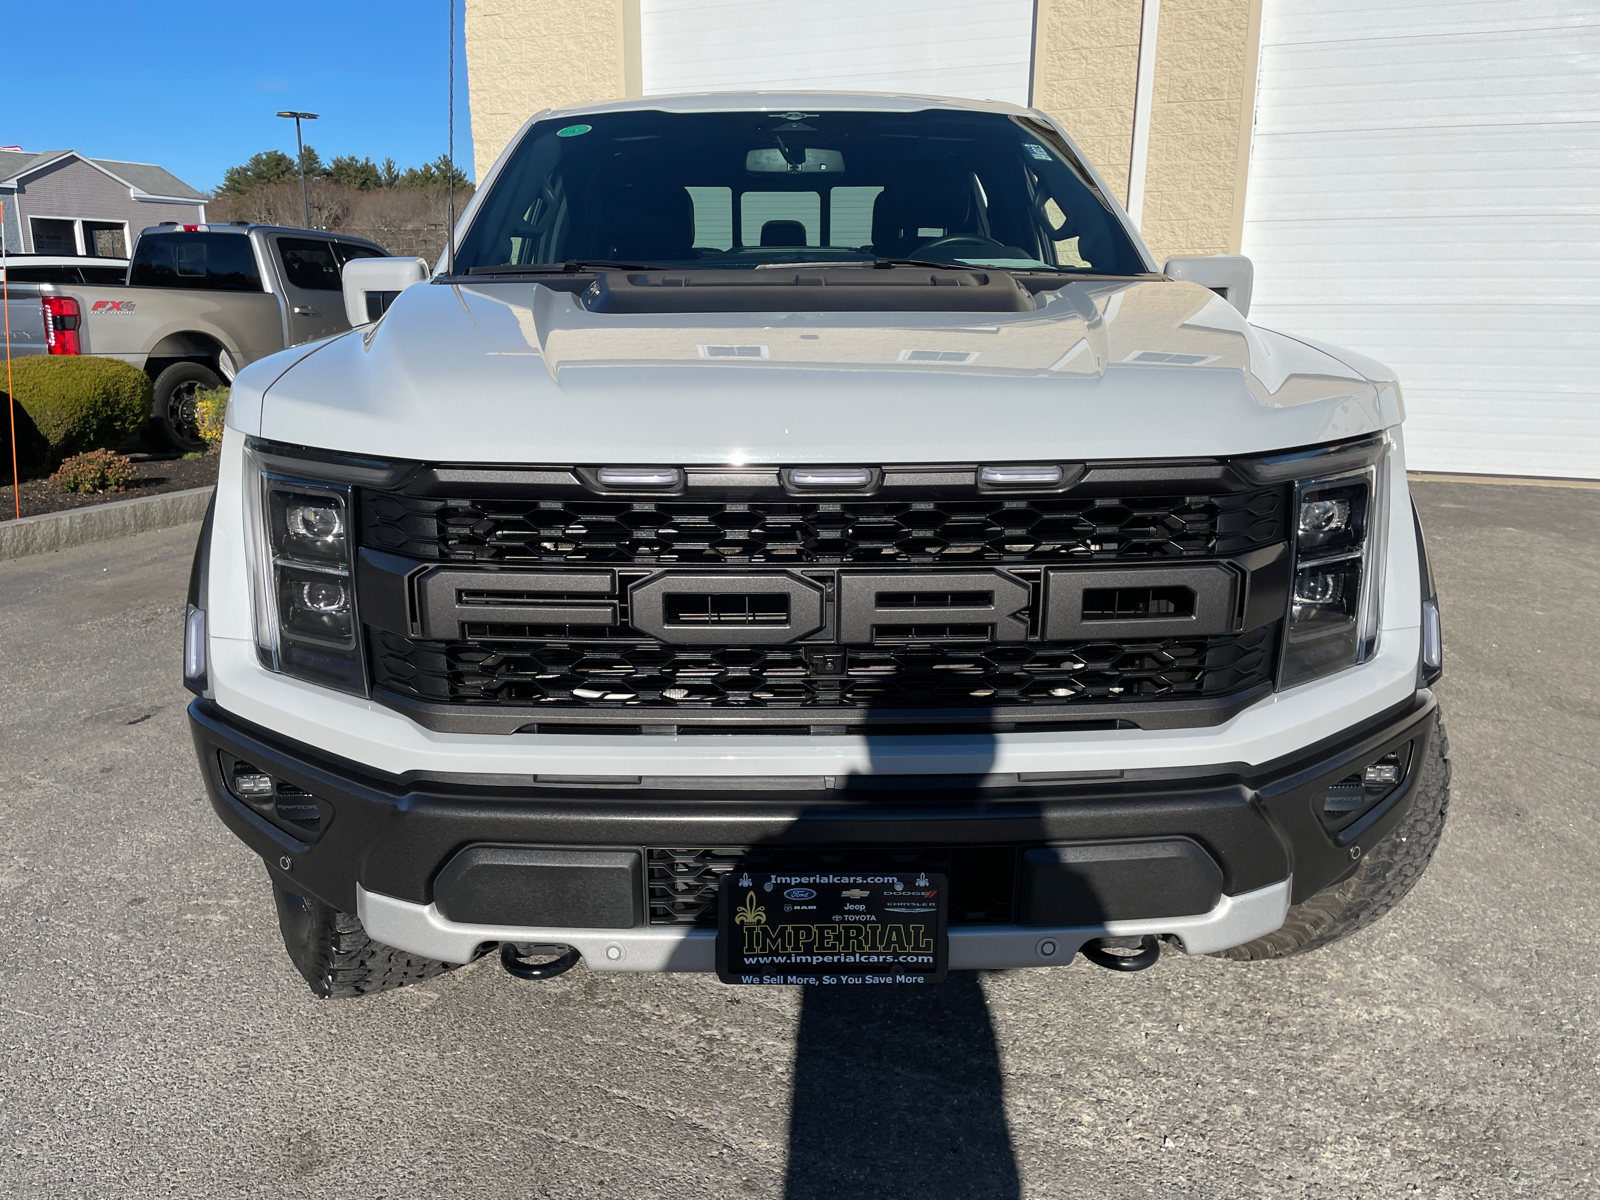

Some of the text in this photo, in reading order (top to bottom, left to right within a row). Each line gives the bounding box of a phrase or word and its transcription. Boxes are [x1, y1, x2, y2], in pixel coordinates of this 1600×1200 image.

[91, 300, 136, 310] FX4
[420, 565, 1237, 645] FORD
[770, 874, 898, 886] Imperialcars.com
[790, 890, 809, 898] Ford
[844, 903, 866, 912] Jeep
[743, 924, 933, 955] IMPERIAL
[743, 953, 934, 965] www.imperialcars.com
[741, 974, 925, 986] We Sell More, So You Save More
